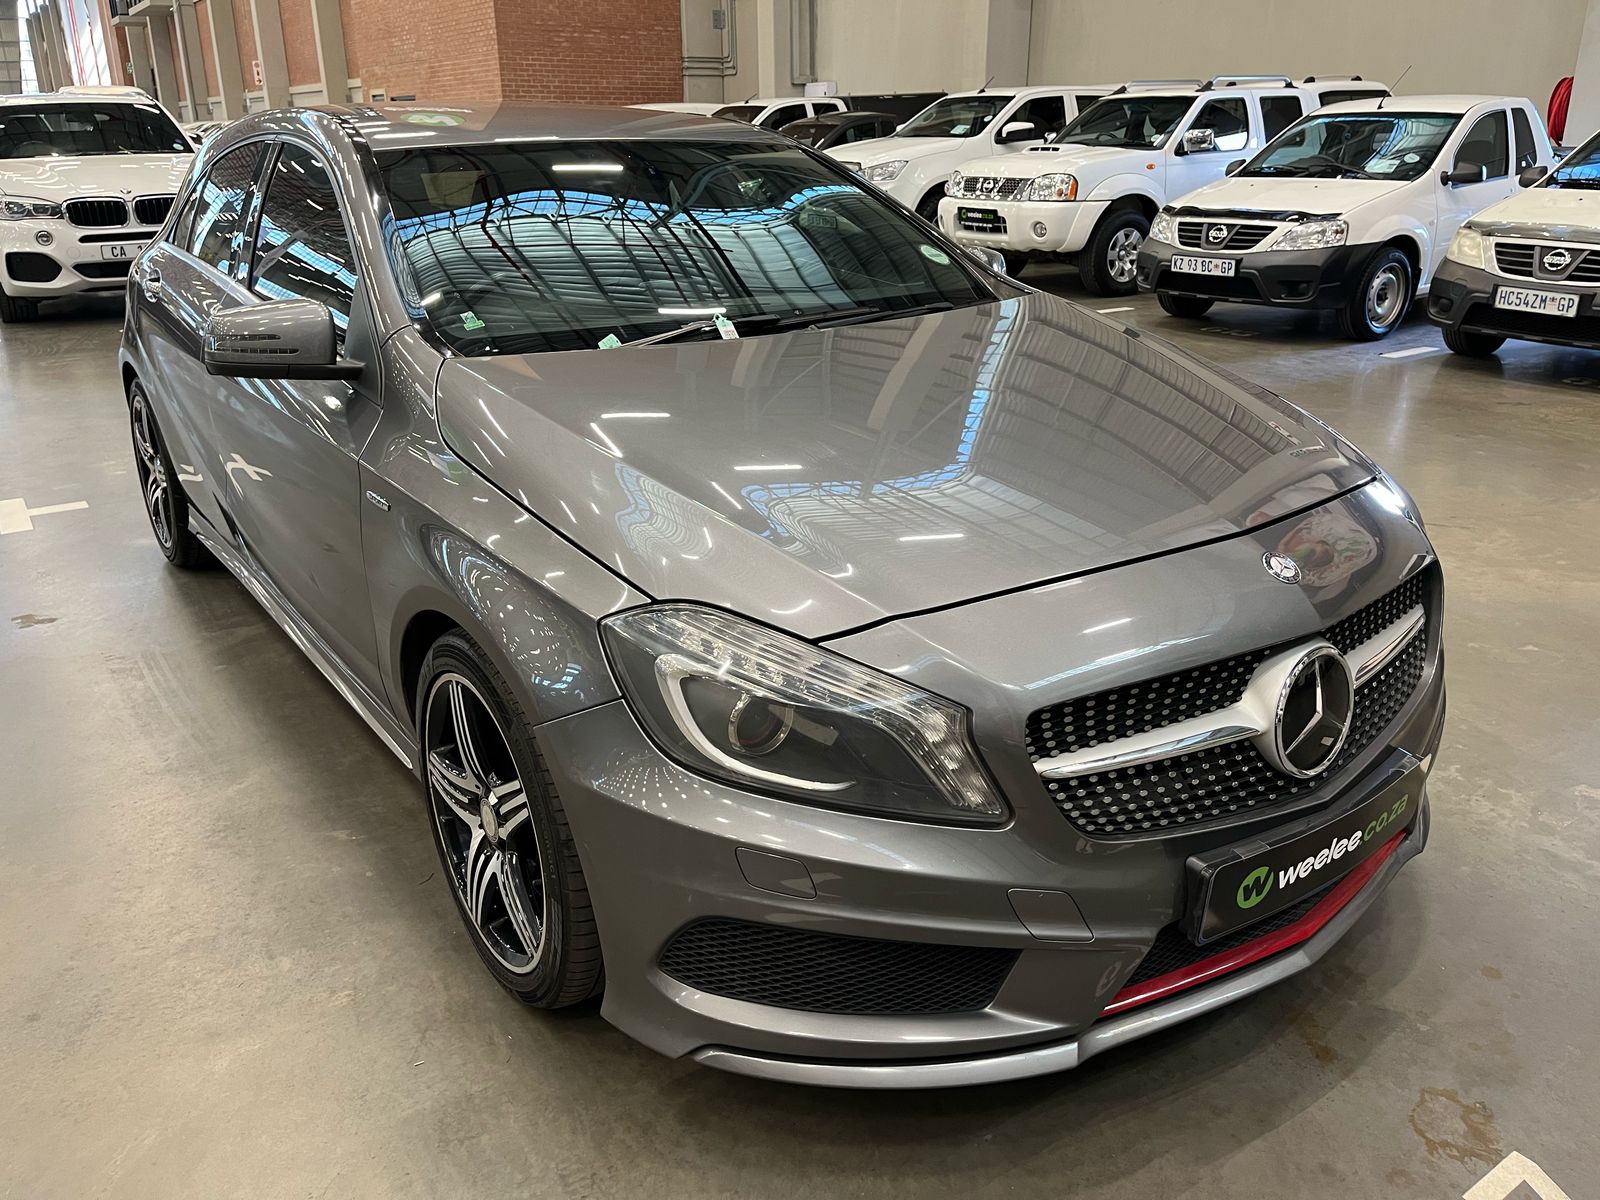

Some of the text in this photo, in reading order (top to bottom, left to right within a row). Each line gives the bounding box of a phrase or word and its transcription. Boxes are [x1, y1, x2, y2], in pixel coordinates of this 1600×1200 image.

[111, 246, 127, 258] CA
[1173, 257, 1233, 275] KZ 93 BC GP
[1498, 290, 1575, 313] HC54ZM GP
[1279, 794, 1409, 889] weelee.co.za
